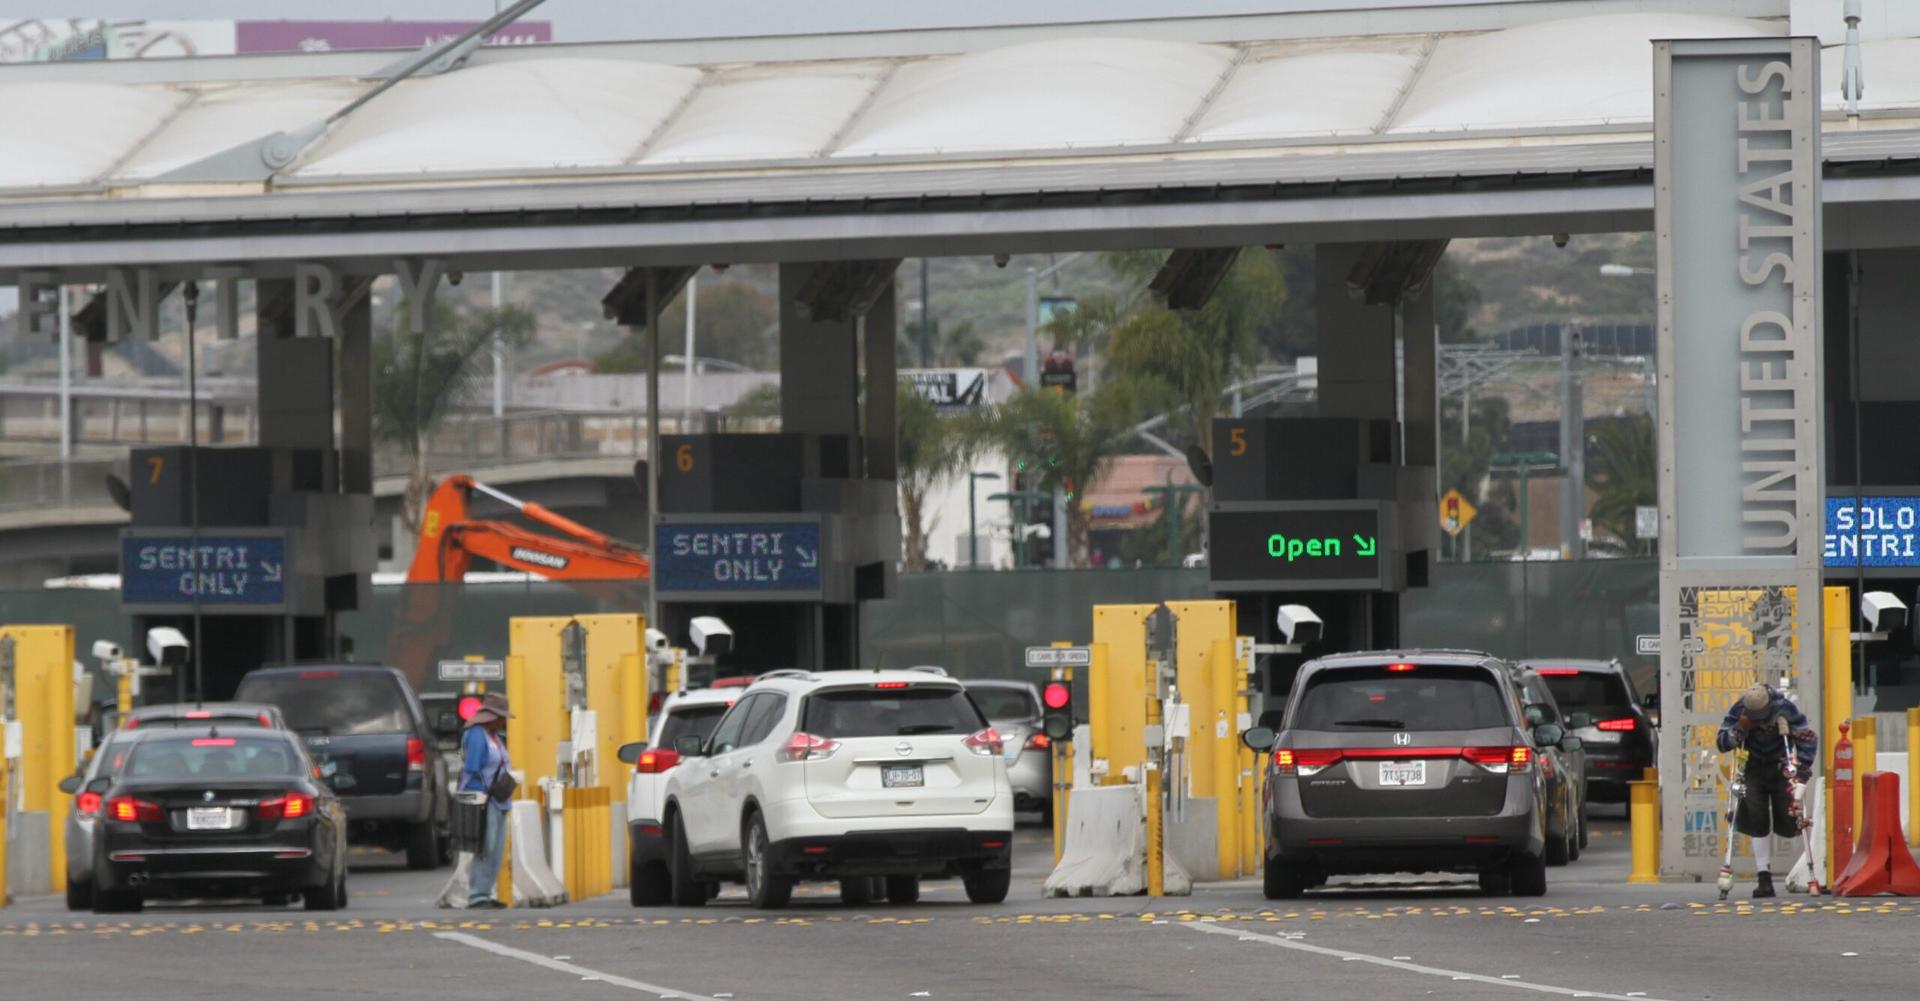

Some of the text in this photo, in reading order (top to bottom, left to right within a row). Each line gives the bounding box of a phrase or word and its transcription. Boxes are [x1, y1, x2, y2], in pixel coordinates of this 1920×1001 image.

[19, 260, 444, 342] ENTRY
[1738, 60, 1797, 549] UNITED STATES
[1231, 428, 1247, 457] 5
[148, 455, 164, 486] 7
[676, 444, 694, 472] 6
[1837, 507, 1915, 529] SOLO
[672, 533, 784, 556] SENTRI
[1268, 534, 1341, 562] Open
[1823, 534, 1915, 557] ENTRI
[139, 546, 249, 570] SENTRI
[714, 558, 784, 582] ONLY
[179, 571, 248, 595] ONLY
